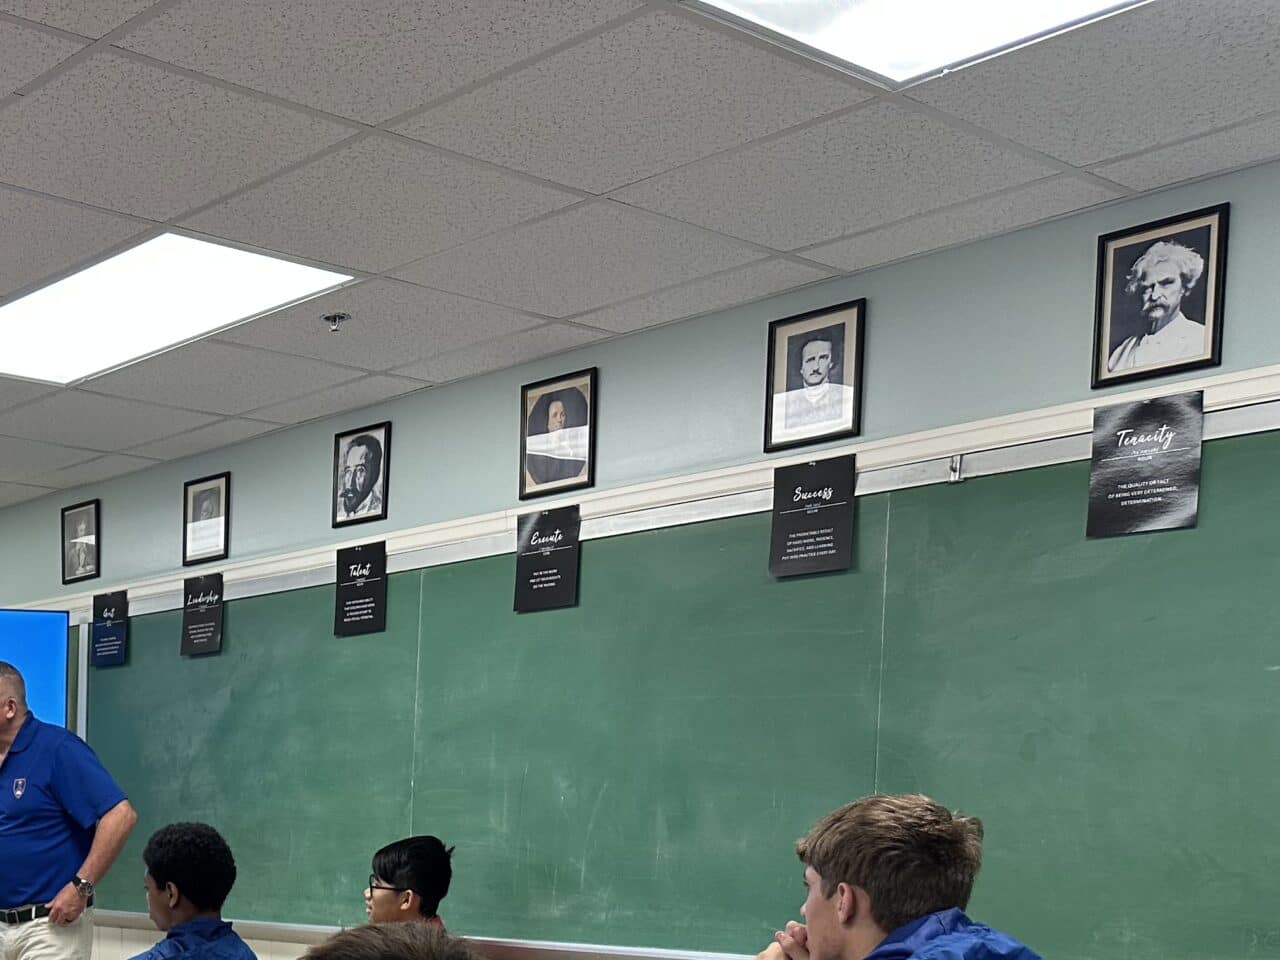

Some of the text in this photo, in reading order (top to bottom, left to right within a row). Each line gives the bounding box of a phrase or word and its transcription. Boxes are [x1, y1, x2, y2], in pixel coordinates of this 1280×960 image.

[1116, 424, 1177, 450] Tenacity
[793, 486, 834, 502] Success
[530, 529, 564, 545] Execute
[349, 563, 372, 577] Talent
[186, 590, 219, 606] Leadership
